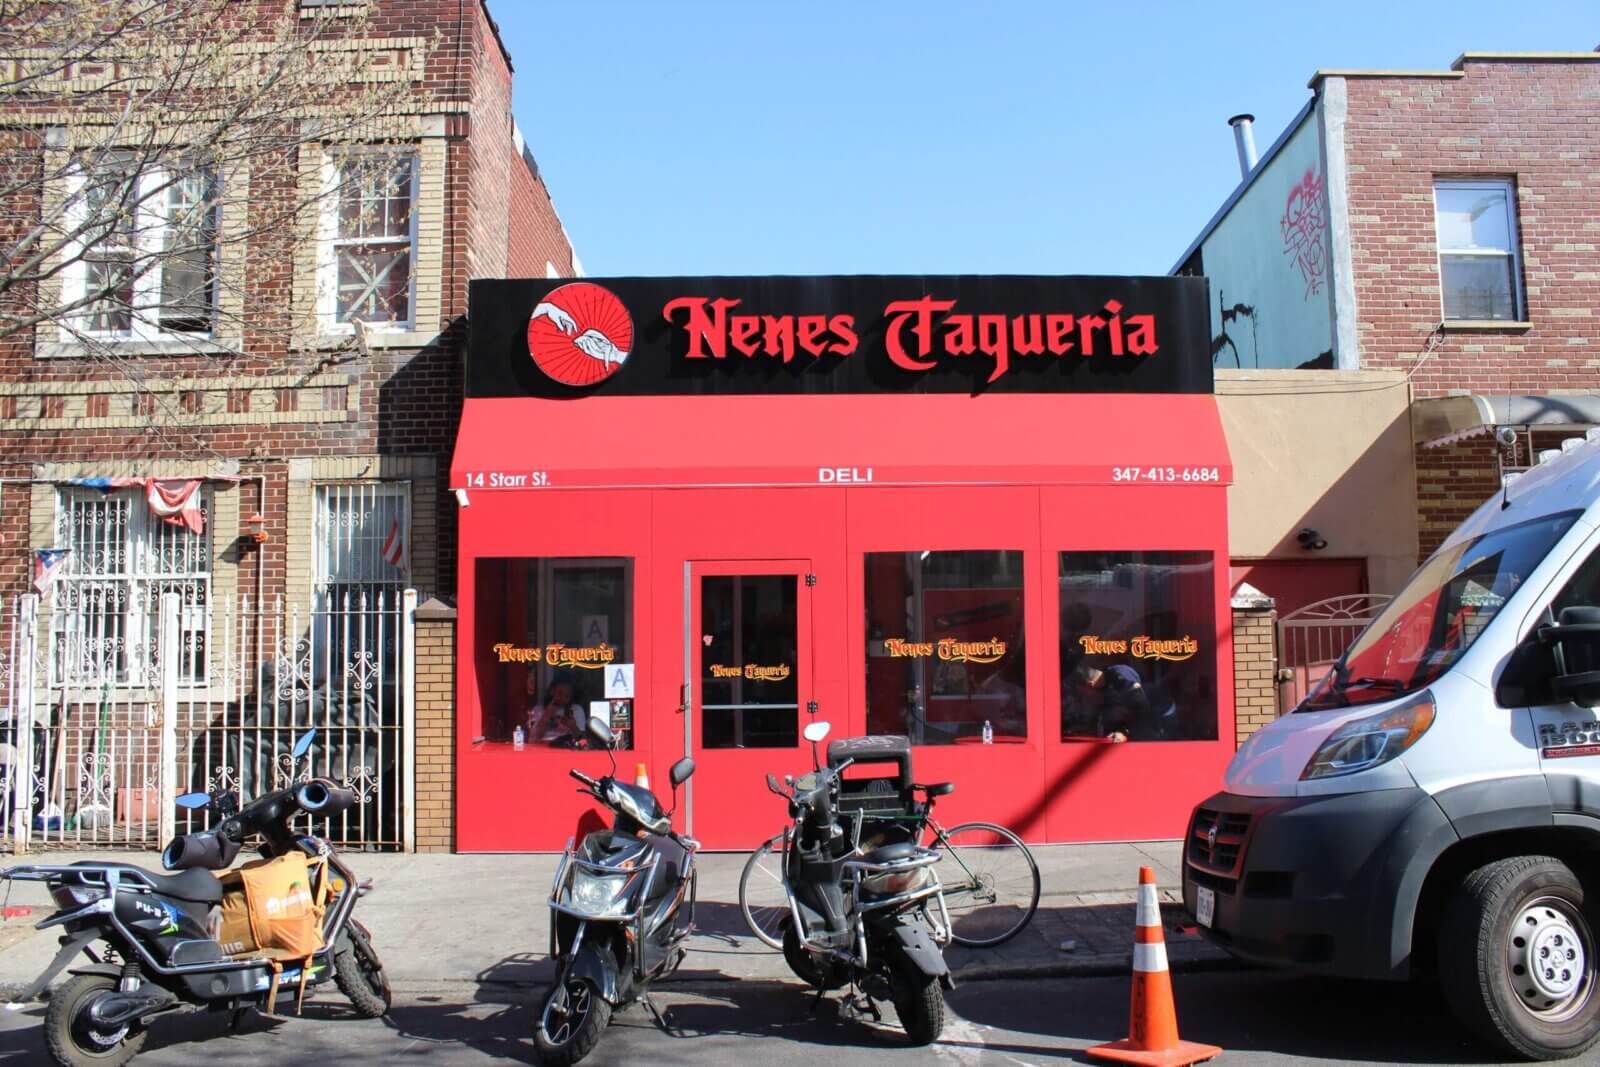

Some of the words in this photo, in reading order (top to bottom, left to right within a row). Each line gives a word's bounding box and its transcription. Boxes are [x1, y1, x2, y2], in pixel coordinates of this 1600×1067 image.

[663, 297, 859, 364] Nenes
[884, 295, 1160, 383] Taqueria
[466, 472, 484, 487] 14
[489, 472, 527, 487] Starr
[531, 471, 551, 486] St.
[819, 467, 873, 482] DELI
[1112, 467, 1219, 481] 347-413-6684
[493, 642, 542, 662] Nenes
[545, 642, 616, 669] Taqueria
[884, 638, 934, 657] Nenes
[937, 636, 1006, 663] Taqueria
[1079, 635, 1128, 655] Nenes
[1130, 634, 1198, 661] Taqueria
[612, 668, 627, 688] A
